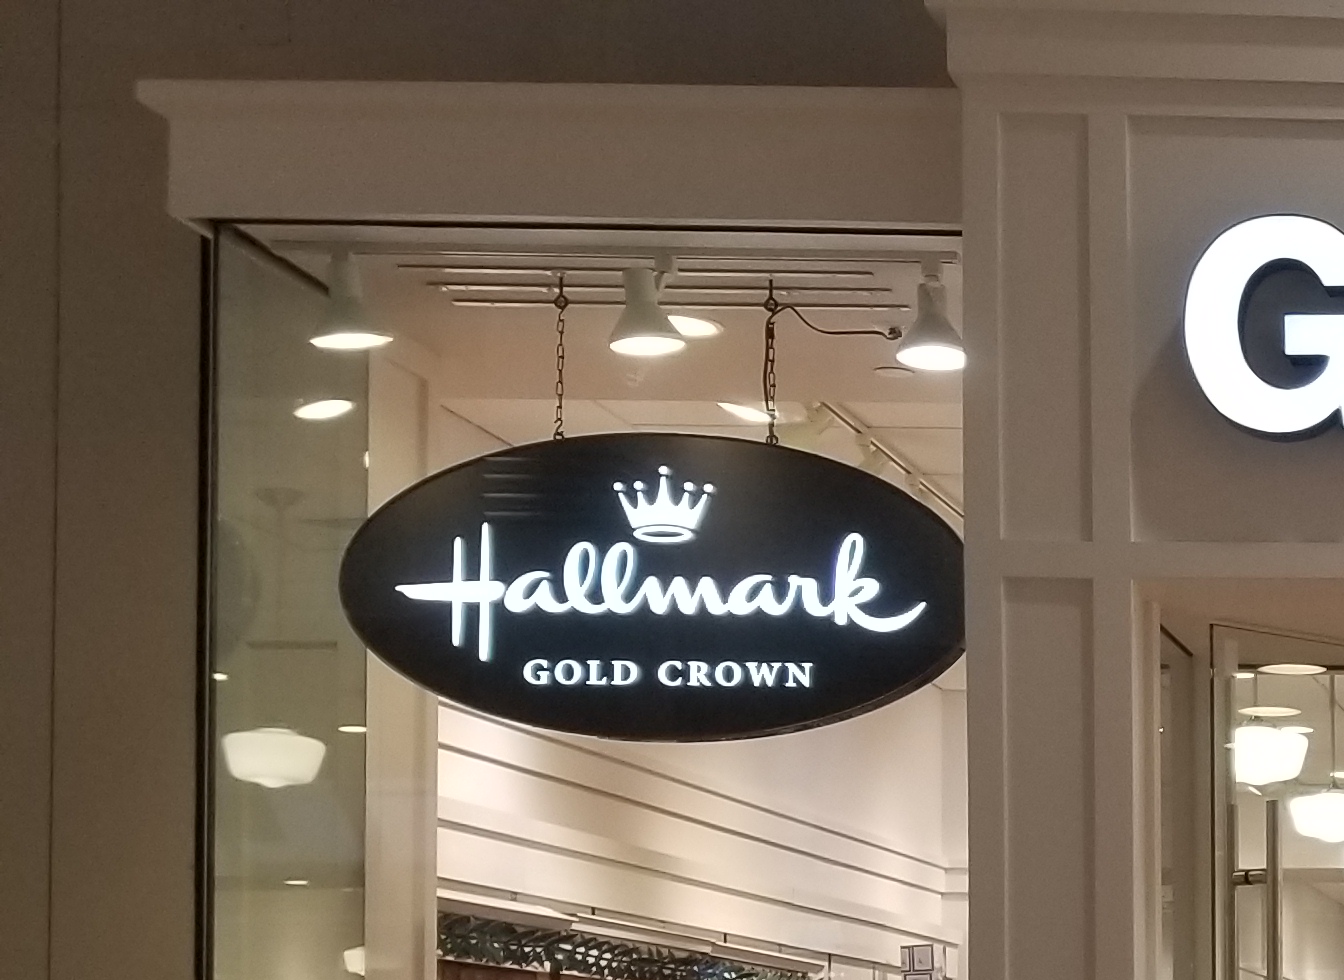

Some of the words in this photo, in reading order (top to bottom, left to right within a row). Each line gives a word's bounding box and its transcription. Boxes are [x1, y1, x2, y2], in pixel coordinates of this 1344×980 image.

[394, 521, 927, 661] Hallmark
[523, 658, 638, 686] GOLD
[657, 659, 813, 688] CROWN
